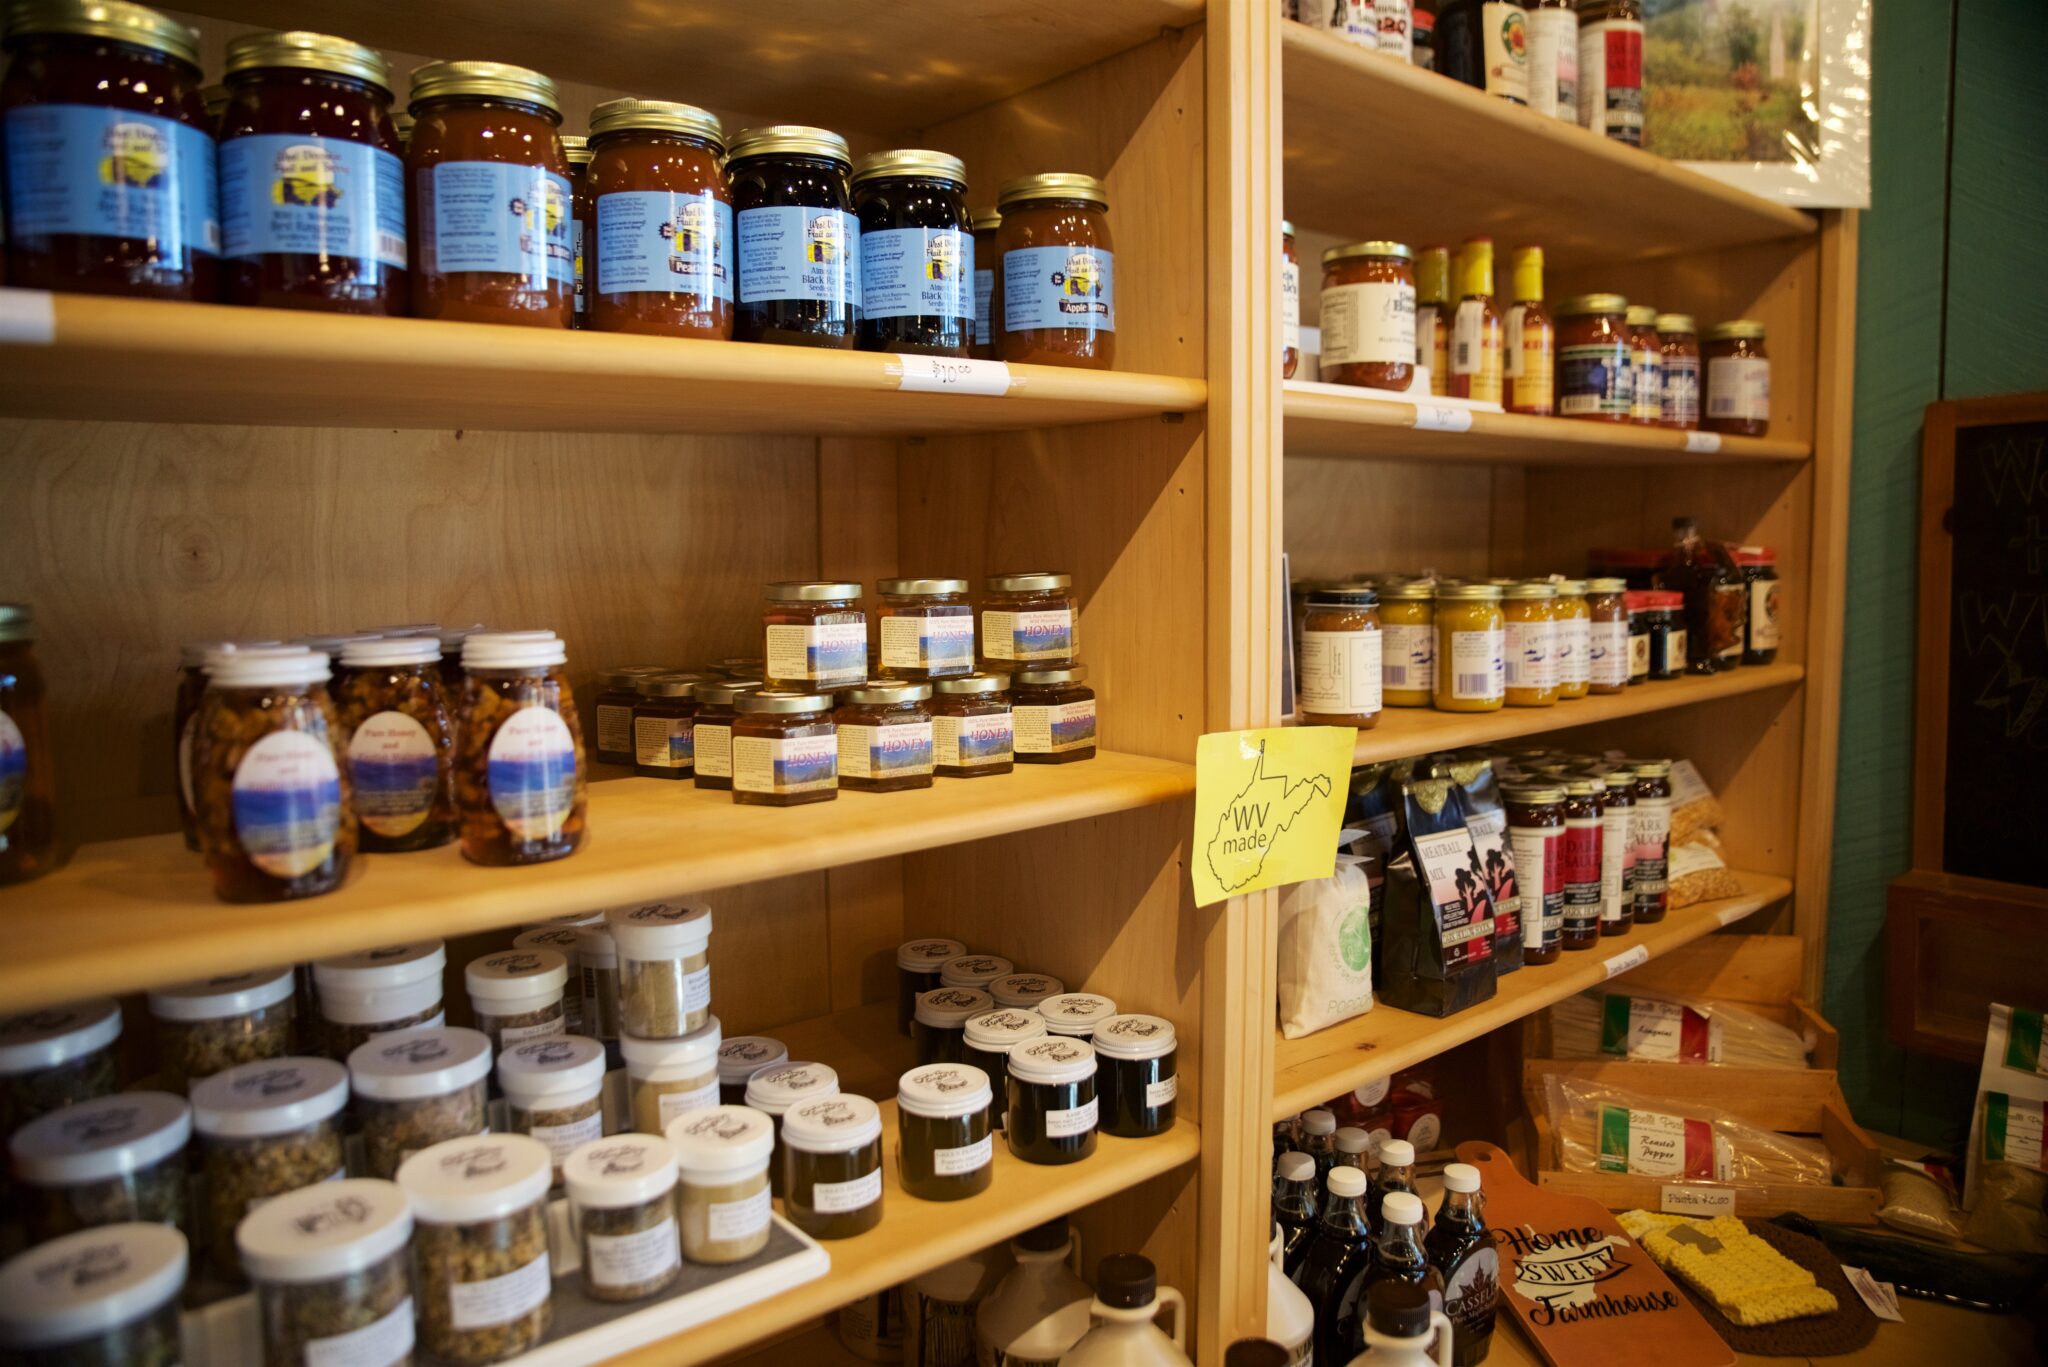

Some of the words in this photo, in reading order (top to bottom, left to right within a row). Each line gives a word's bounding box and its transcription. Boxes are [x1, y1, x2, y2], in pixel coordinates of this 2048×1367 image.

[802, 275, 824, 284] Black
[922, 291, 942, 301] Black
[1066, 303, 1087, 313] Apple
[1024, 623, 1066, 638] HONEY
[1063, 713, 1094, 727] HONEY
[970, 727, 1010, 741] HONEY
[882, 737, 926, 753] HONEY
[788, 750, 832, 768] HONEY
[1233, 801, 1271, 833] WV
[1223, 829, 1267, 856] made
[1421, 840, 1463, 860] MEATBALL
[1428, 866, 1447, 882] MIX
[1640, 1135, 1677, 1149] Roasted
[1641, 1145, 1675, 1160] Pepper
[1668, 1192, 1699, 1205] Pasta
[1490, 1226, 1604, 1256] Home
[1524, 1252, 1614, 1282] SWEET
[1528, 1290, 1681, 1327] Farmhouse
